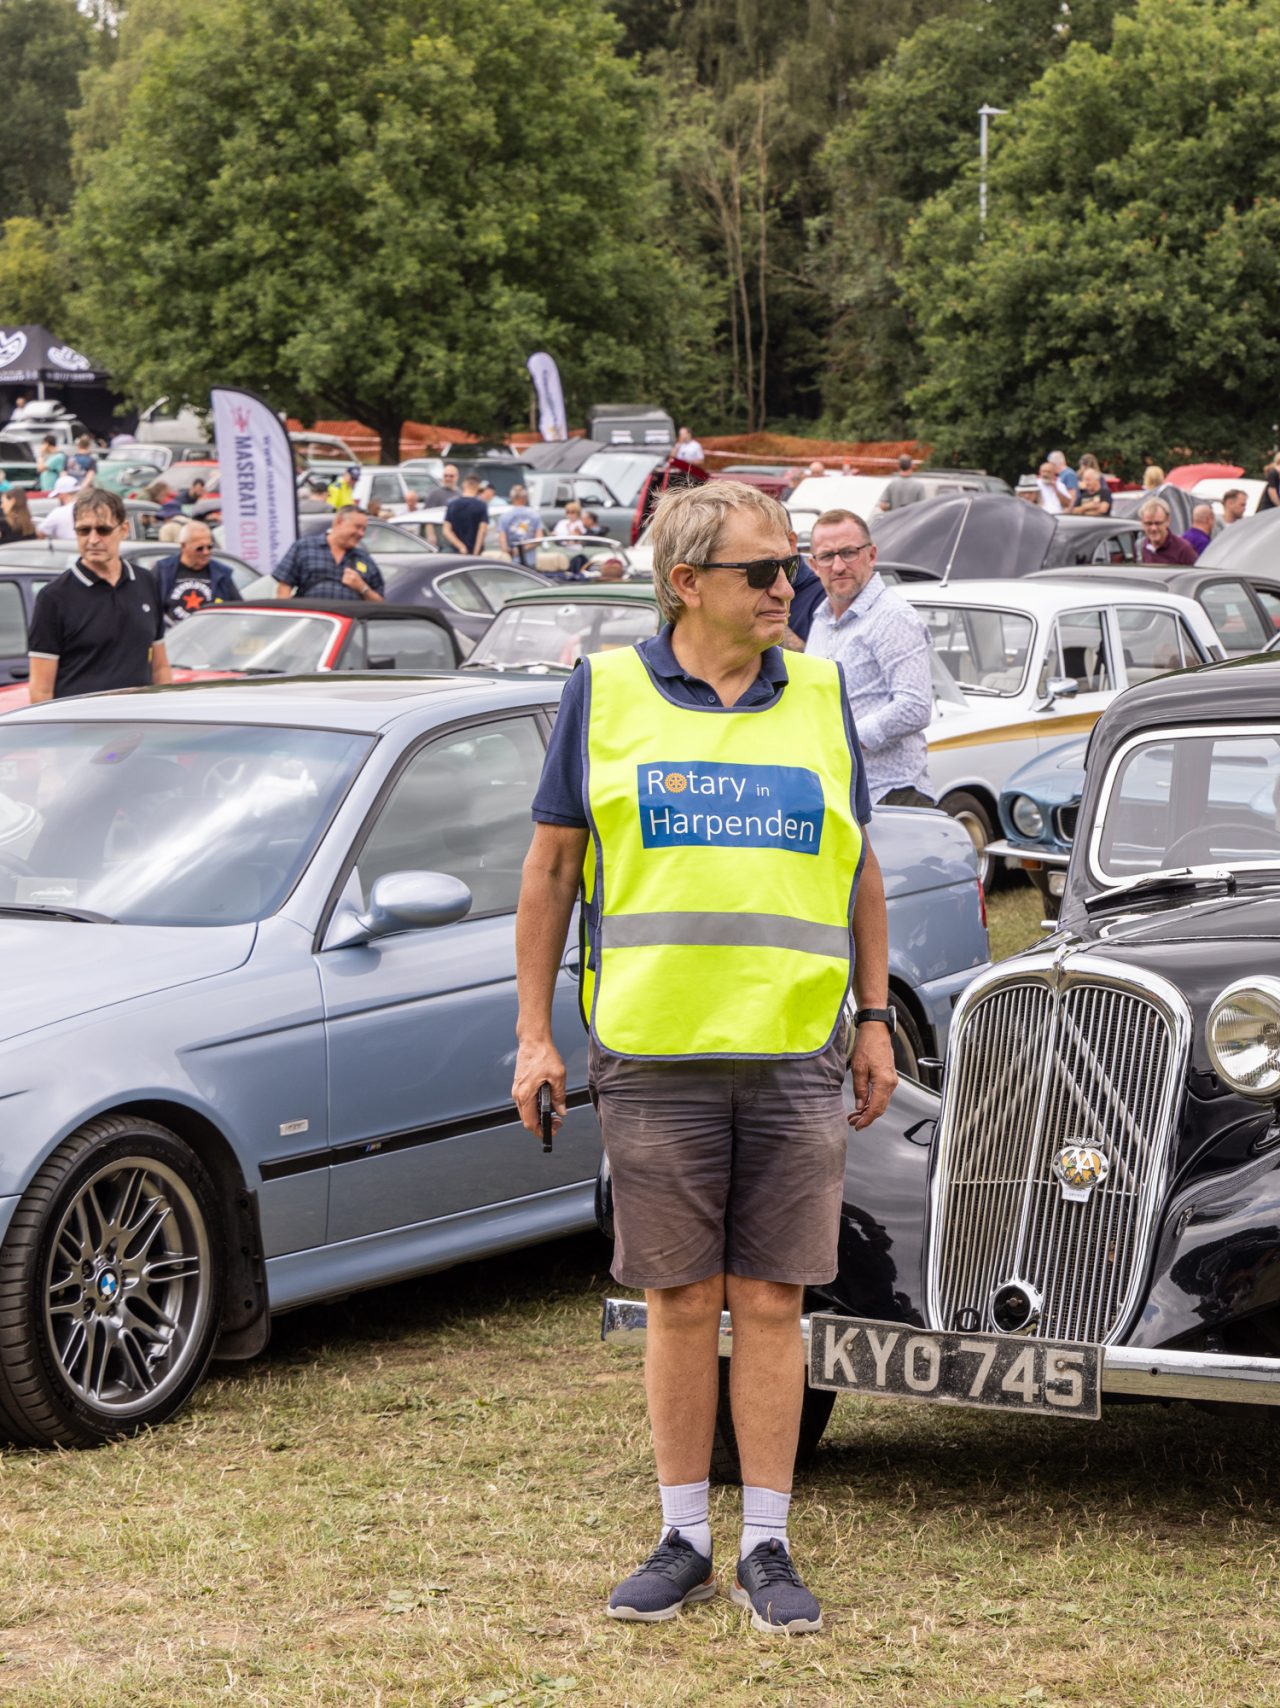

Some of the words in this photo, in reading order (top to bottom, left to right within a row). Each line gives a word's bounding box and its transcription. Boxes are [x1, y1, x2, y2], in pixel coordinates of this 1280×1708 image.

[234, 435, 258, 517] MASERATI
[239, 520, 260, 561] CLUB
[647, 769, 746, 802] Rotary
[756, 783, 770, 797] in
[649, 807, 815, 842] Harpenden
[824, 1324, 941, 1392] KYO
[960, 1339, 1085, 1408] 745
